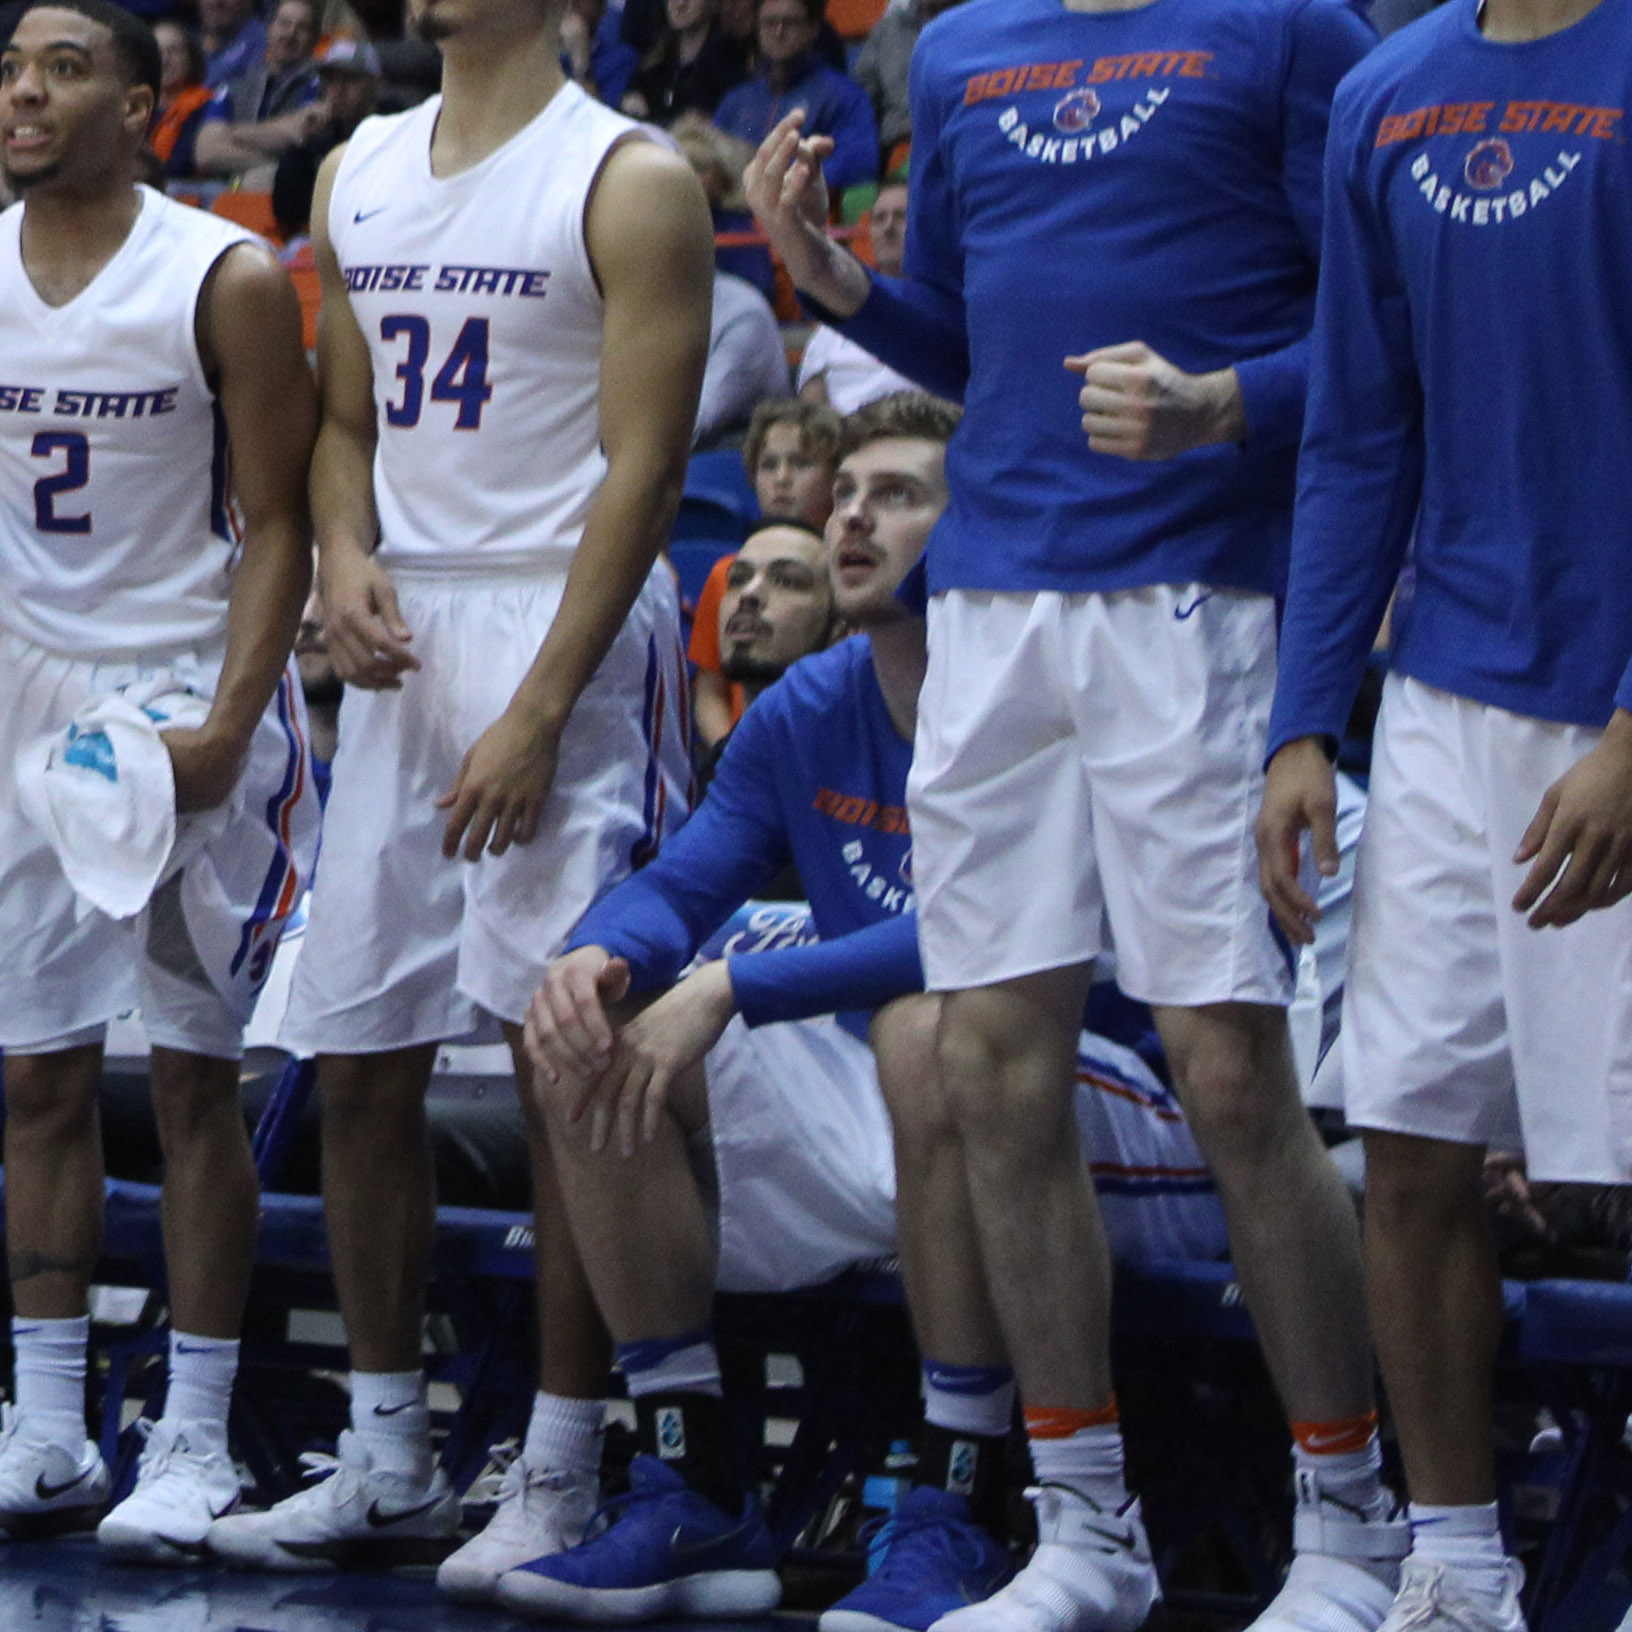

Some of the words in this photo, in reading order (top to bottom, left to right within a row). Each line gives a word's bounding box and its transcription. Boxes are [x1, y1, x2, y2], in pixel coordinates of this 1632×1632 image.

[963, 58, 1085, 108] BOISE
[1086, 50, 1215, 82] STATE
[997, 85, 1170, 164] BASKETBALL
[1375, 101, 1496, 150] BOISE
[1498, 100, 1625, 140] STATE
[1409, 147, 1582, 226] BASKETBALL
[433, 265, 552, 299] STATE
[53, 383, 180, 419] STATE
[379, 313, 494, 432] 34
[29, 428, 92, 536] 2
